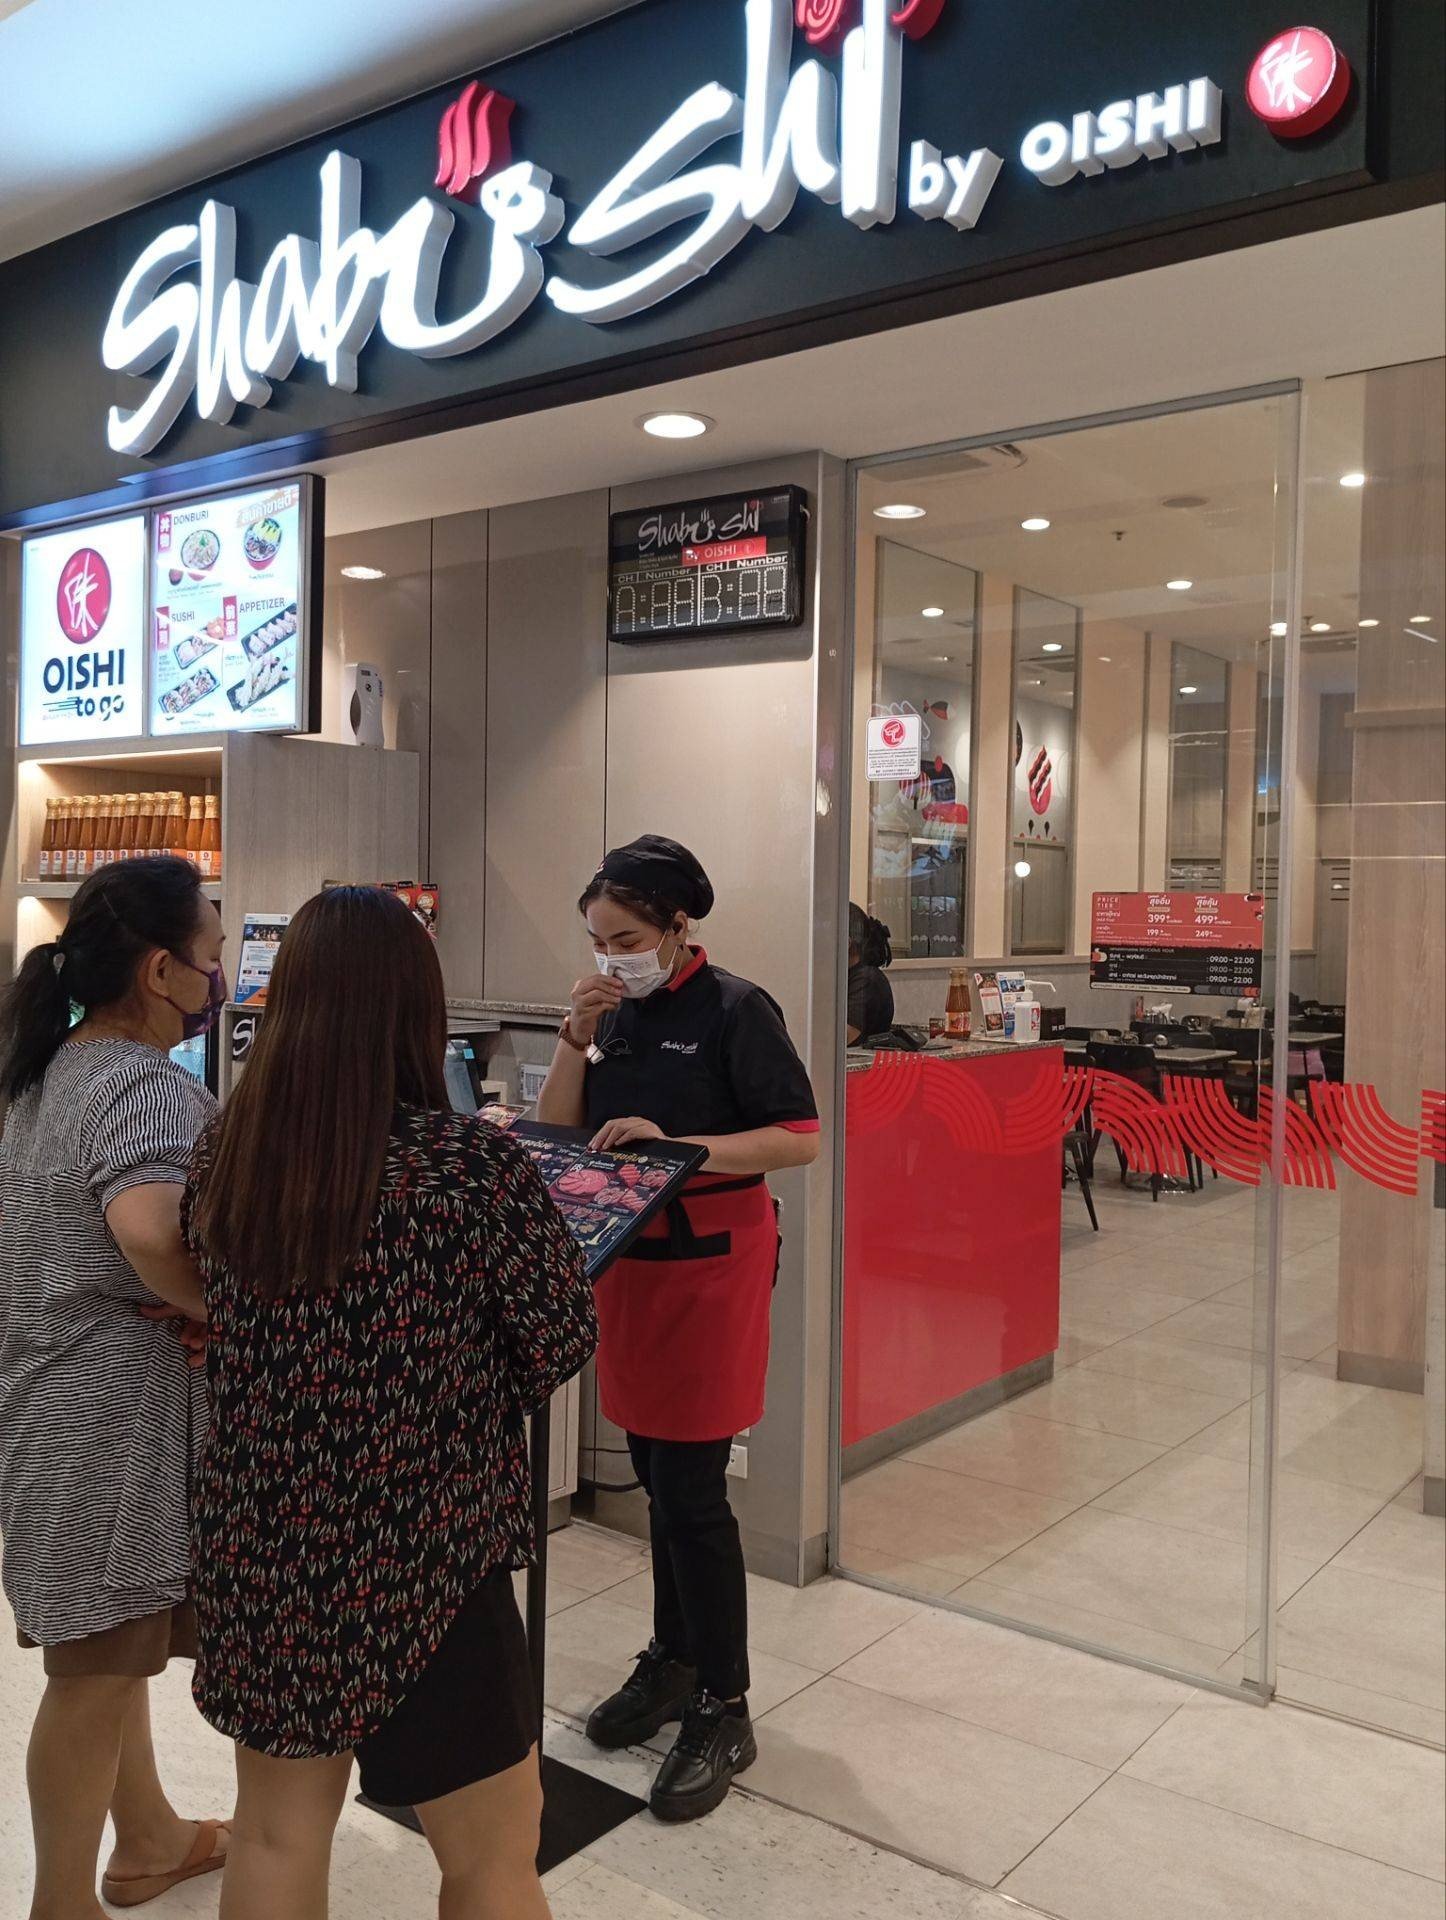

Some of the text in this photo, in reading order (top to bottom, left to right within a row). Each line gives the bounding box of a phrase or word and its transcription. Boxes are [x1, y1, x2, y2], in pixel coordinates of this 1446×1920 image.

[909, 139, 1003, 232] by
[1019, 76, 1221, 186] OISHI
[173, 509, 209, 525] DONBURI
[704, 545, 737, 558] OISHI
[706, 555, 788, 572] CH Number
[617, 567, 692, 583] CH Number
[240, 597, 285, 613] APPETIZER
[171, 611, 195, 622] SUSHI
[43, 648, 125, 694] OISHI
[76, 696, 96, 716] to
[100, 694, 124, 721] go
